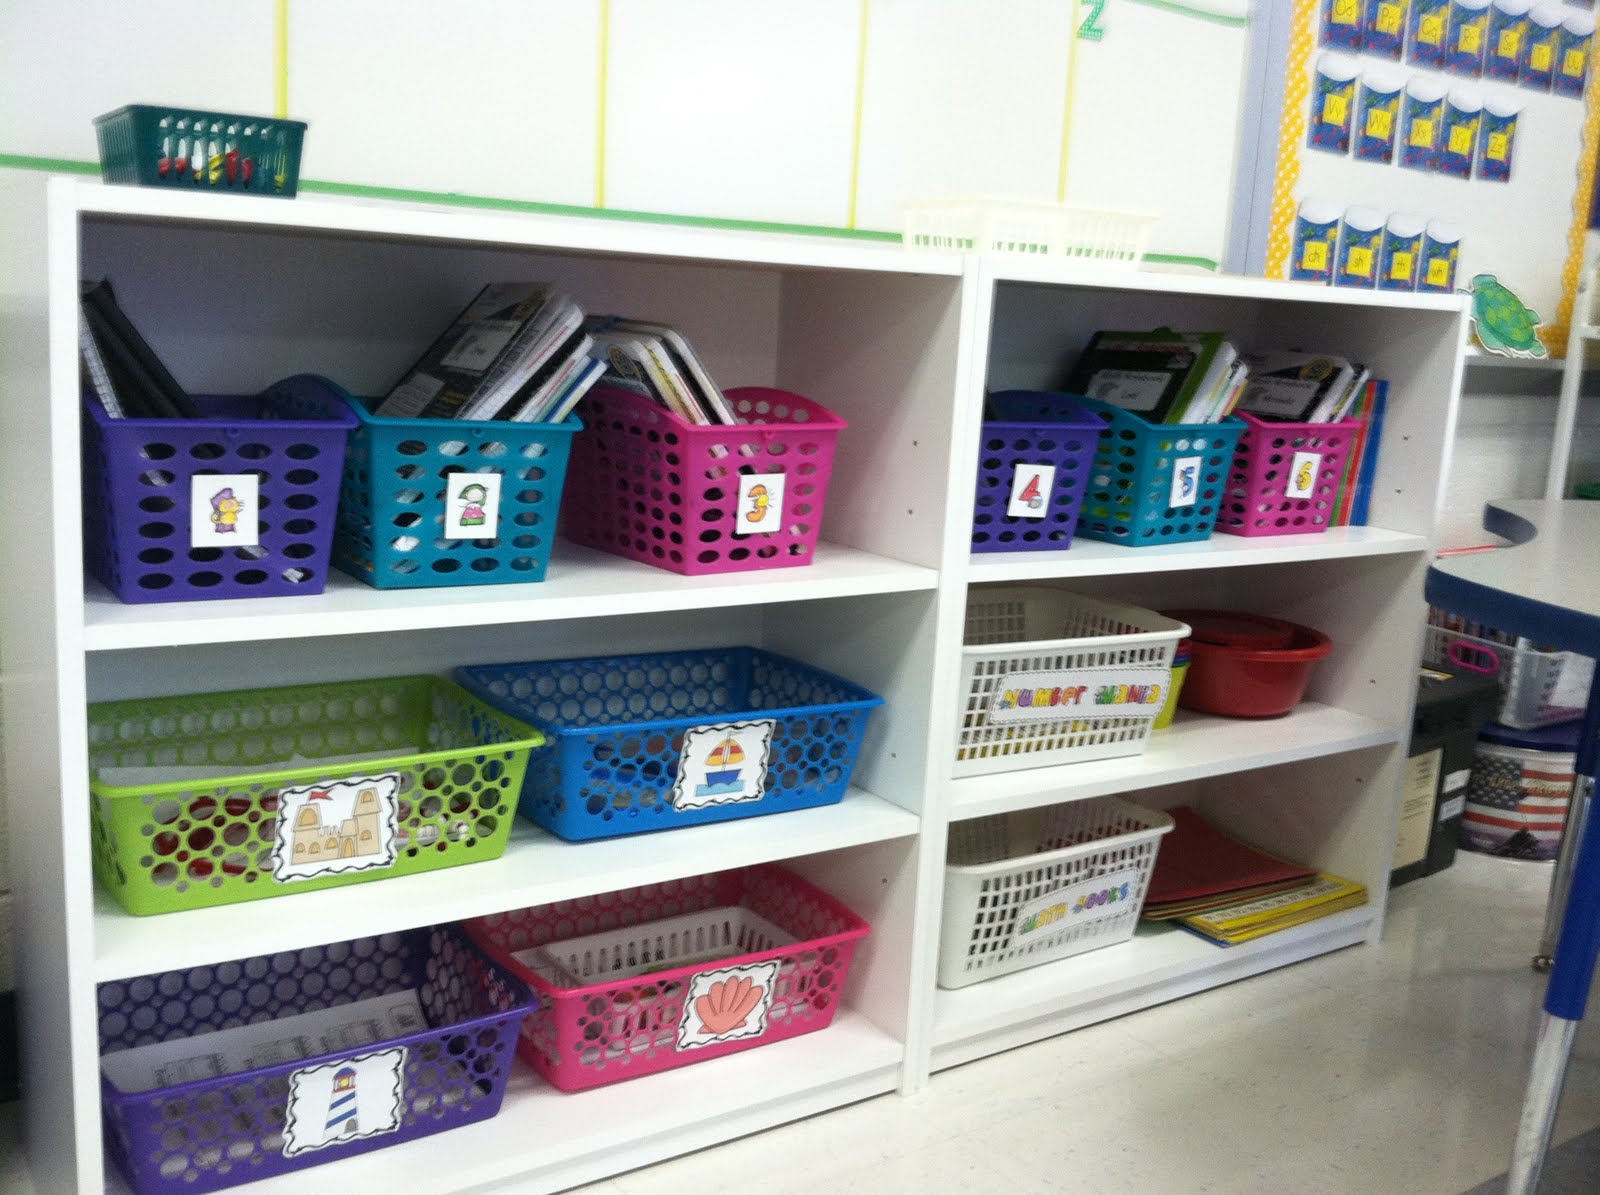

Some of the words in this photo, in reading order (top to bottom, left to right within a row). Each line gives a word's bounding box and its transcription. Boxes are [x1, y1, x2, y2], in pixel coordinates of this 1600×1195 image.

[1018, 474, 1043, 509] 4
[1296, 461, 1313, 491] 6
[746, 484, 769, 523] 3
